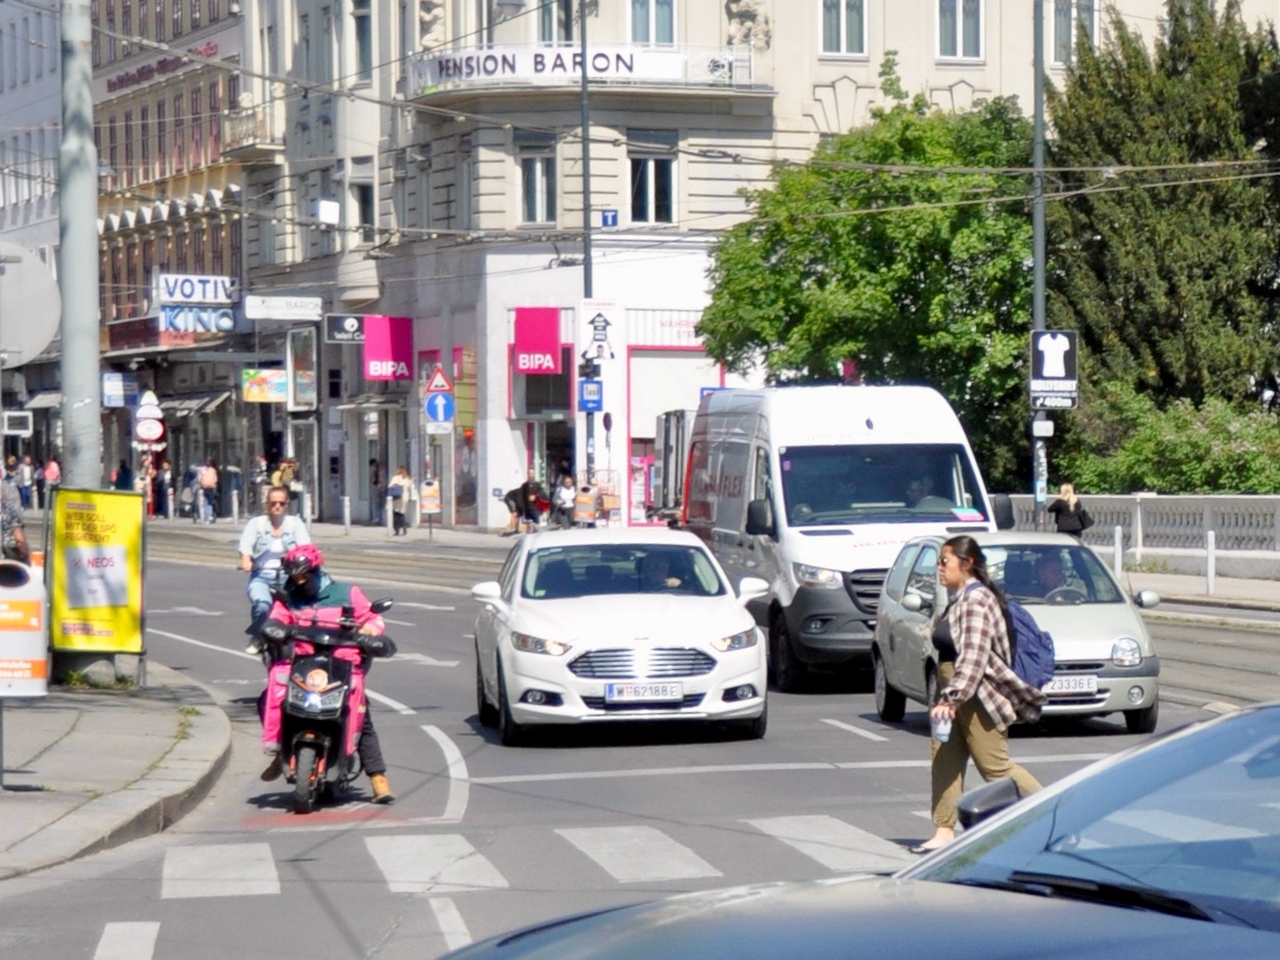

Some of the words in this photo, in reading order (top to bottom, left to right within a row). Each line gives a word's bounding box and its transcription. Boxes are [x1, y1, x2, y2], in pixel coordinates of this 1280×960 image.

[439, 53, 517, 78] PENSION
[534, 53, 634, 73] BARON
[164, 277, 232, 300] VOTIV
[164, 306, 235, 332] KINO
[369, 361, 409, 376] BIPA
[519, 353, 555, 370] BIPA
[1044, 397, 1073, 408] 400m
[86, 556, 115, 568] NEOS
[1051, 679, 1085, 690] 23336
